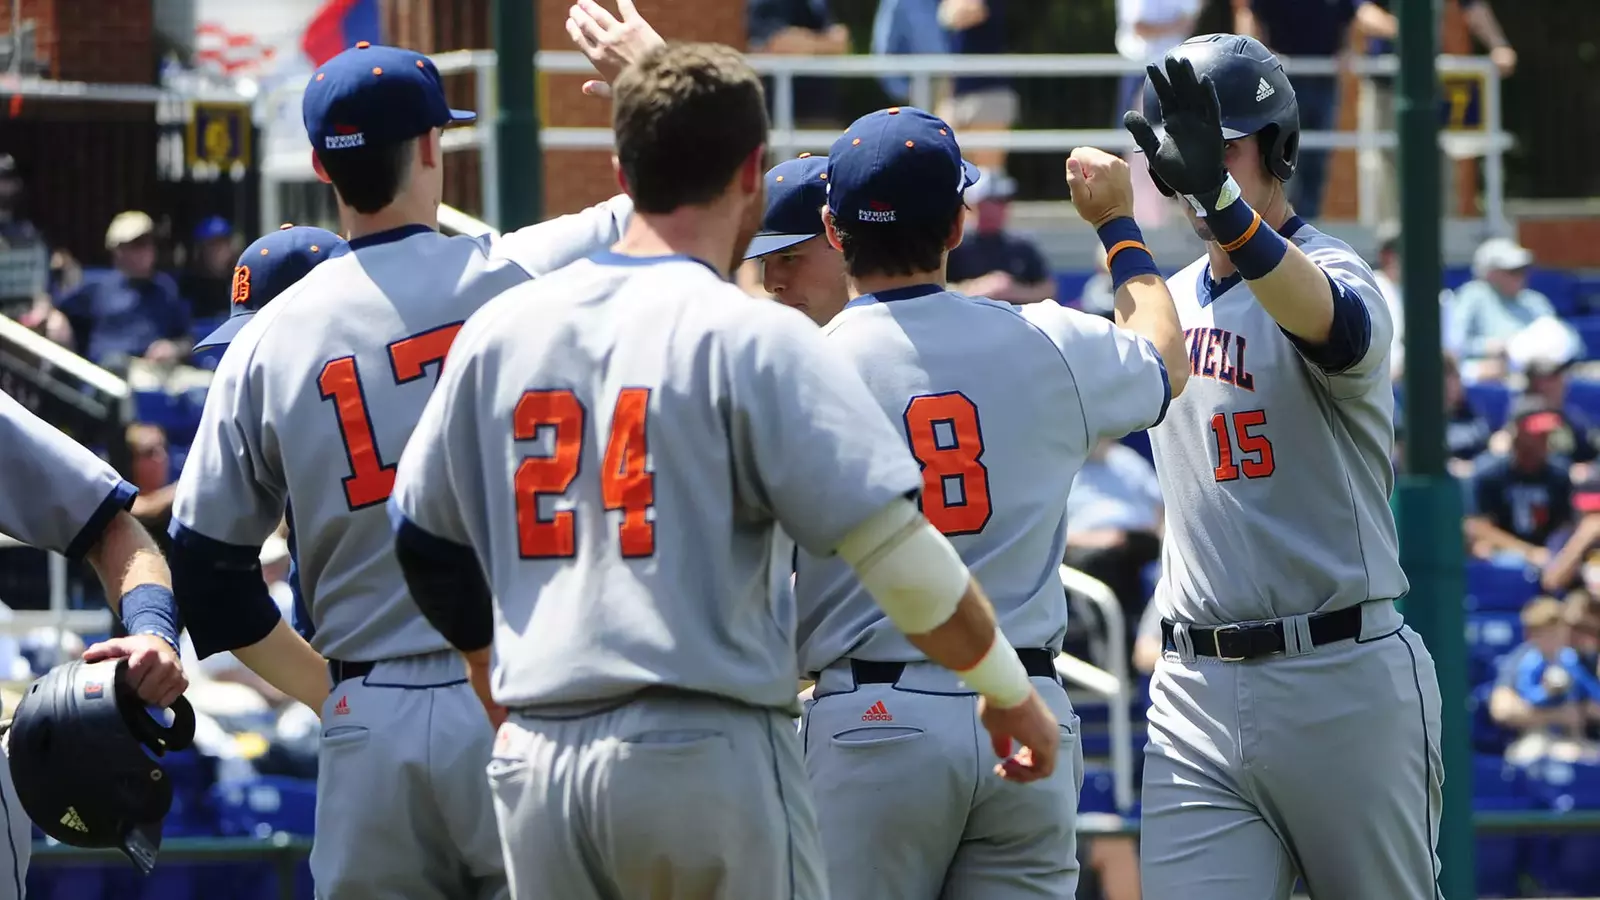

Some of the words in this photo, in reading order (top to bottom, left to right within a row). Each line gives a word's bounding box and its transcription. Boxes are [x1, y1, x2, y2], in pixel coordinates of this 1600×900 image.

[858, 209, 896, 217] PATRIOT
[858, 214, 896, 222] LEAGUE
[232, 265, 250, 304] B
[513, 387, 656, 560] 24
[902, 390, 993, 537] 8
[1210, 409, 1276, 482] 15
